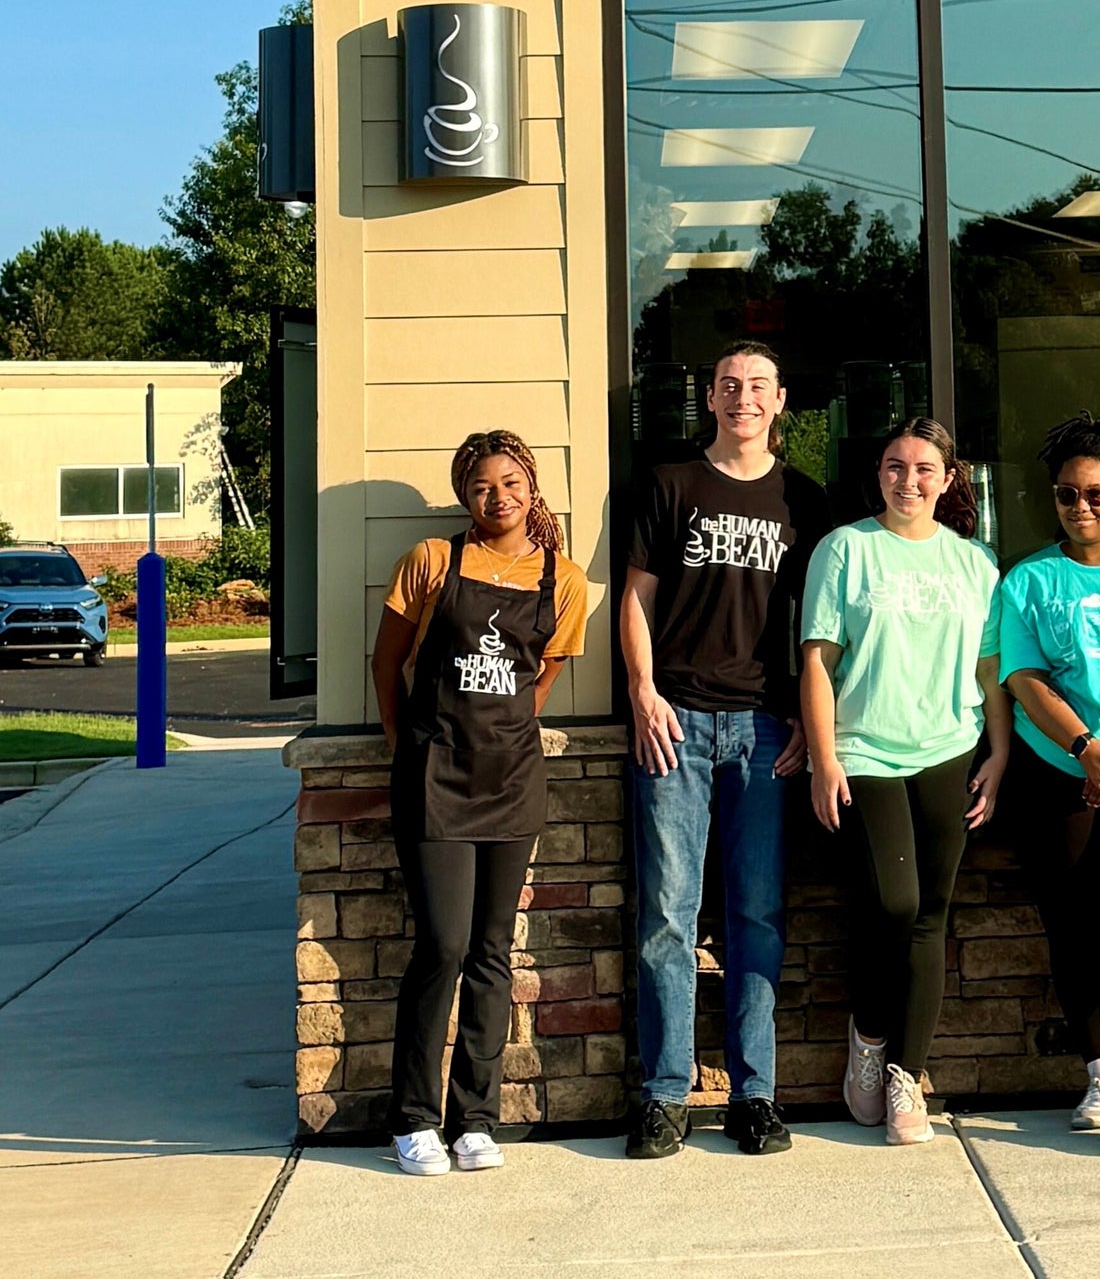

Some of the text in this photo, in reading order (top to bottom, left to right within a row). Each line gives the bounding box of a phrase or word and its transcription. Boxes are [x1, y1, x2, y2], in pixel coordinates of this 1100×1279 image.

[701, 513, 782, 542] the HUMAN
[708, 531, 785, 574] BEAN
[467, 653, 515, 673] HUMAN
[458, 668, 517, 696] BEAN
